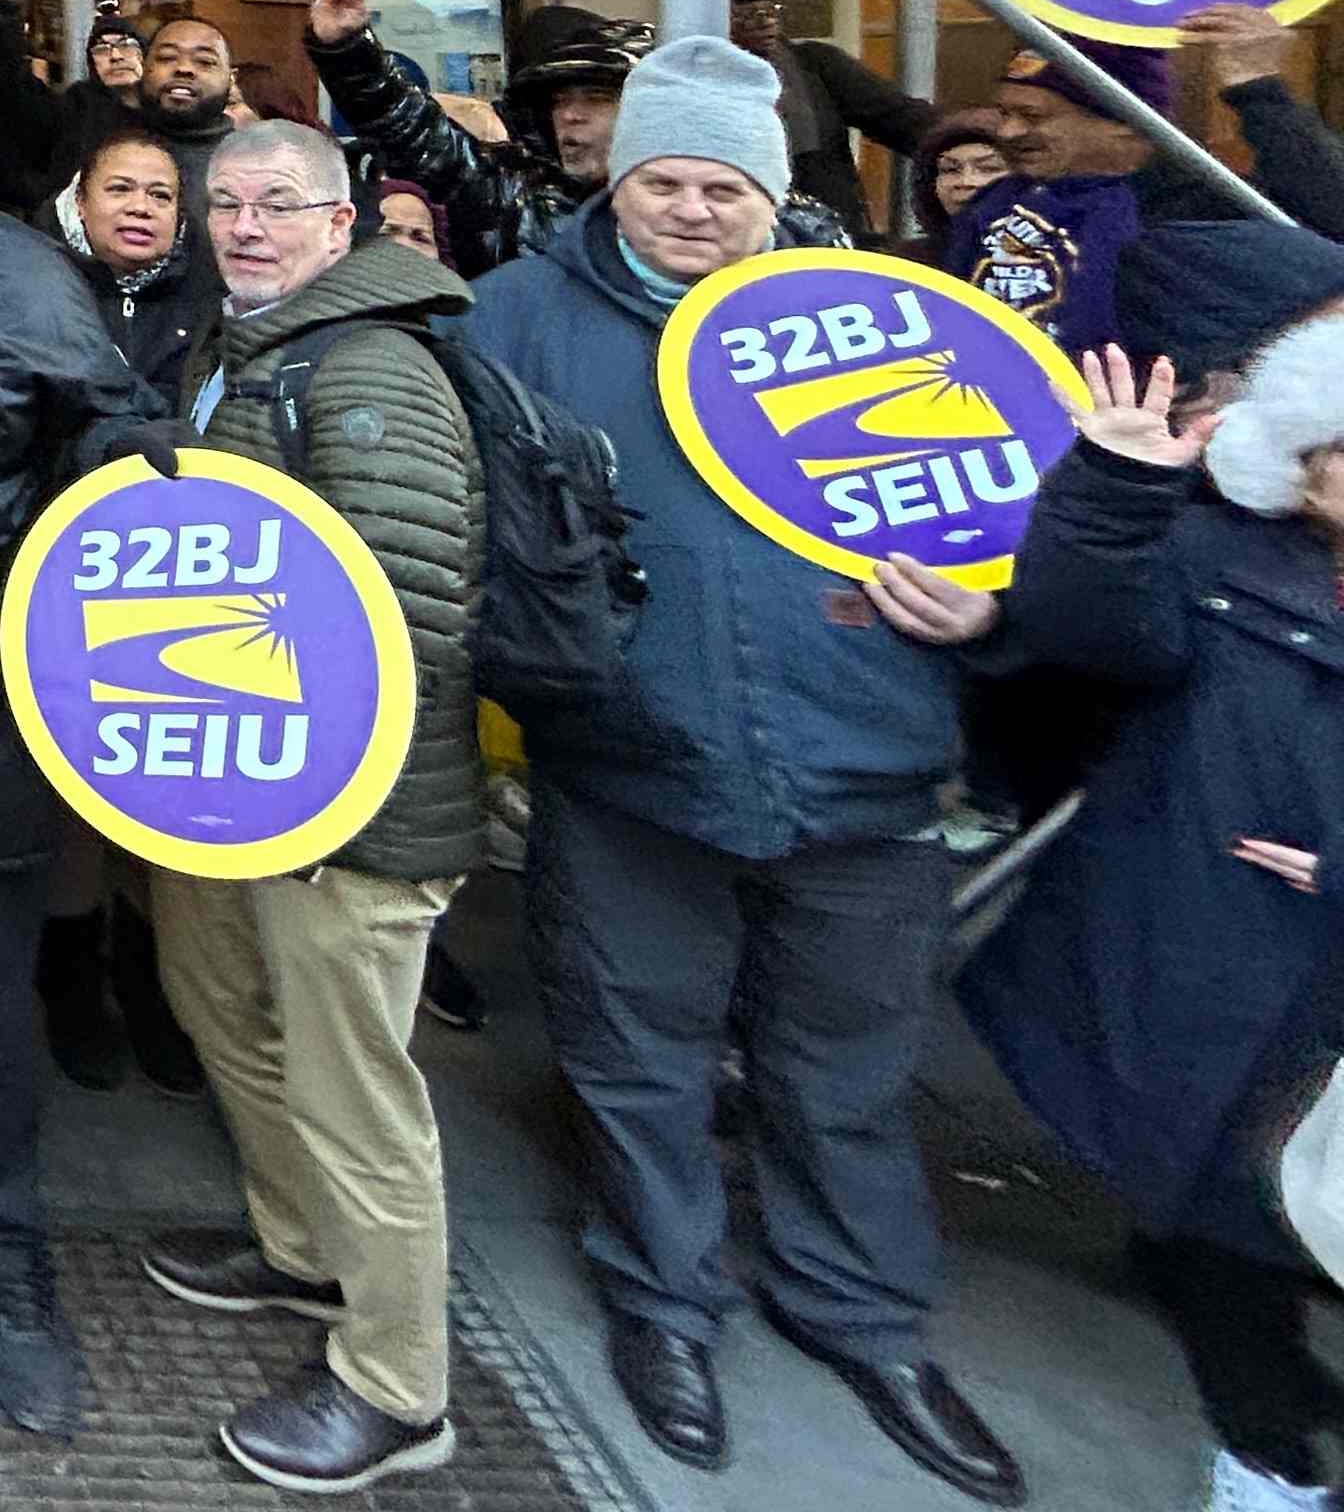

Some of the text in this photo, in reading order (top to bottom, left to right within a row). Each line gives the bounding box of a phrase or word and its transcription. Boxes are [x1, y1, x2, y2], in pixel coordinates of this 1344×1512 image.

[719, 289, 932, 384] 32BJ
[822, 439, 1040, 538] SEIU
[74, 519, 282, 592] 32BJ
[92, 712, 310, 782] SEIU
